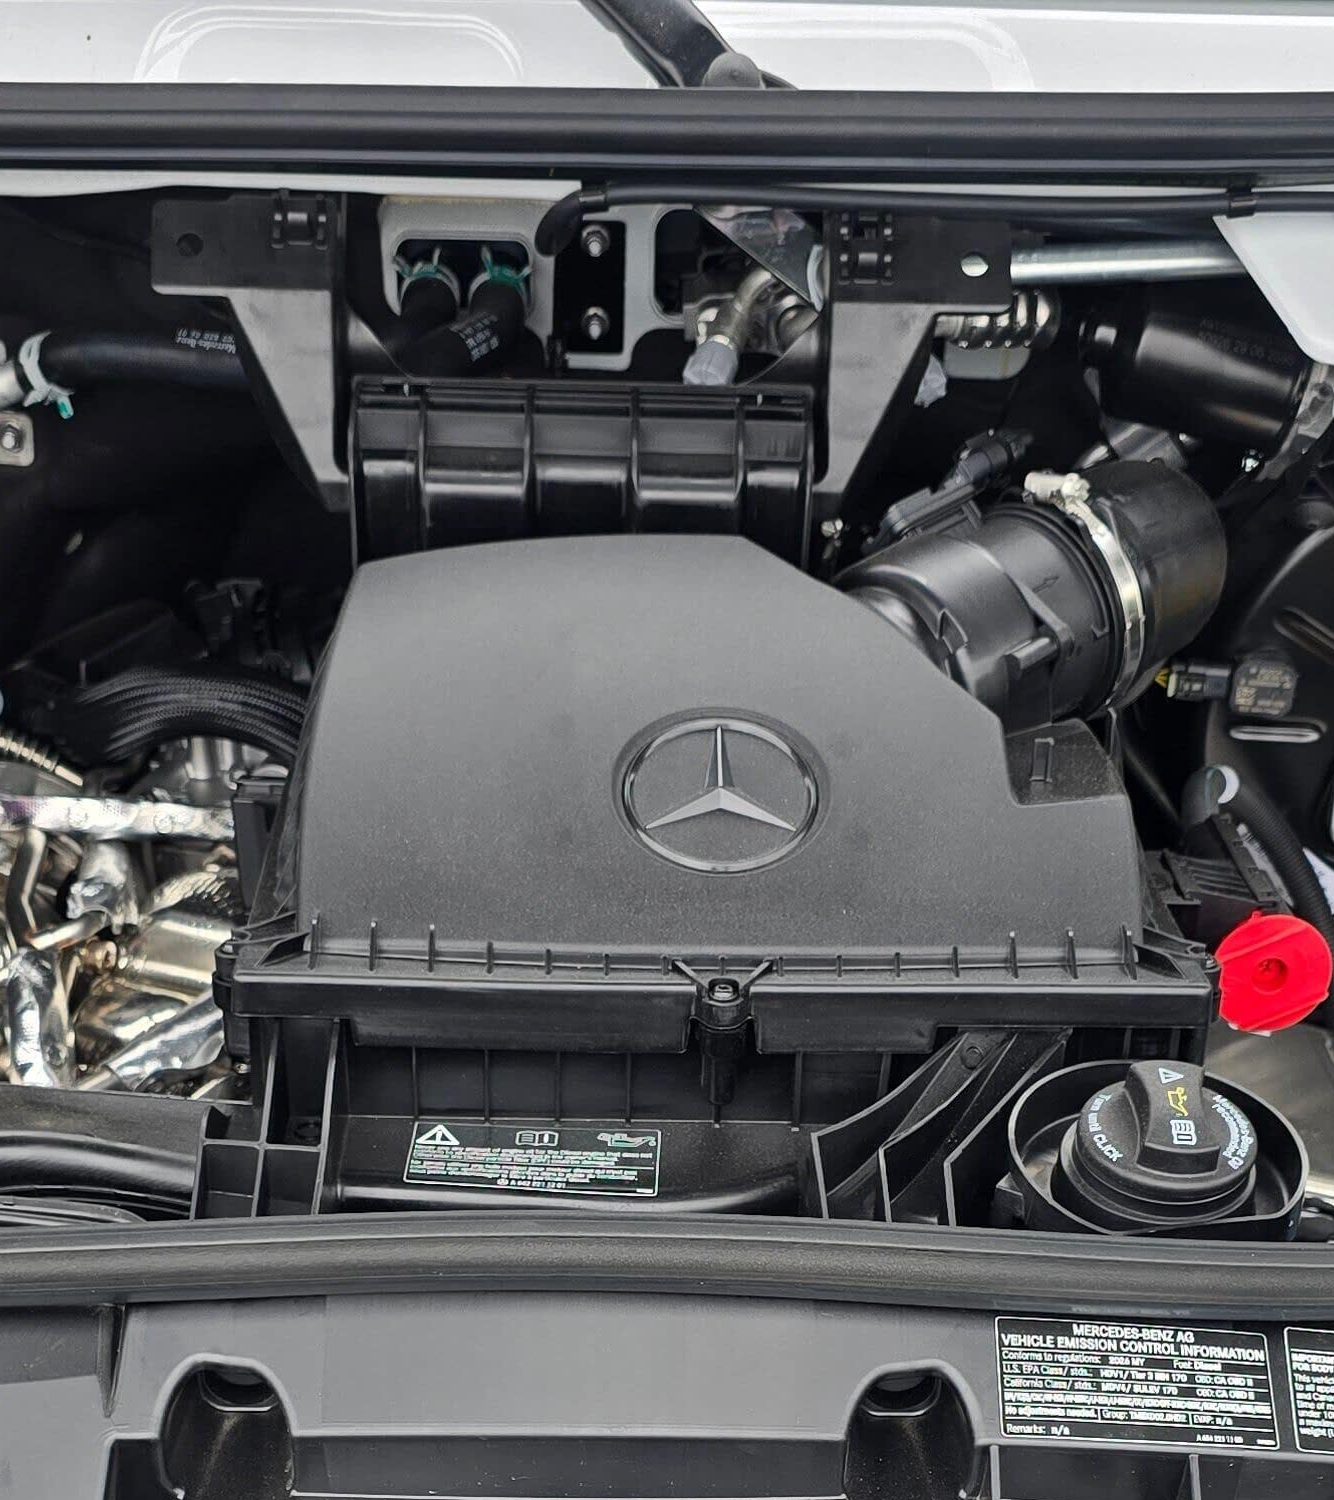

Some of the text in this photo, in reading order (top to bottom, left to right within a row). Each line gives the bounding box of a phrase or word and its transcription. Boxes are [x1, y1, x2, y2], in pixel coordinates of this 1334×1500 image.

[1093, 1134, 1123, 1162] CLICK
[1072, 1323, 1195, 1343] MERCEDES-BENZ AG
[1001, 1333, 1265, 1361] VEHICLE EMISSION CONTROL INFORMATION
[1002, 1351, 1042, 1361] Conforms
[1044, 1352, 1053, 1361] to
[1054, 1353, 1101, 1363] regulations:
[1003, 1364, 1021, 1373] U.S.
[1023, 1365, 1039, 1374] EPA
[1003, 1378, 1043, 1388] California
[1007, 1423, 1070, 1436] Remarks: n/a
